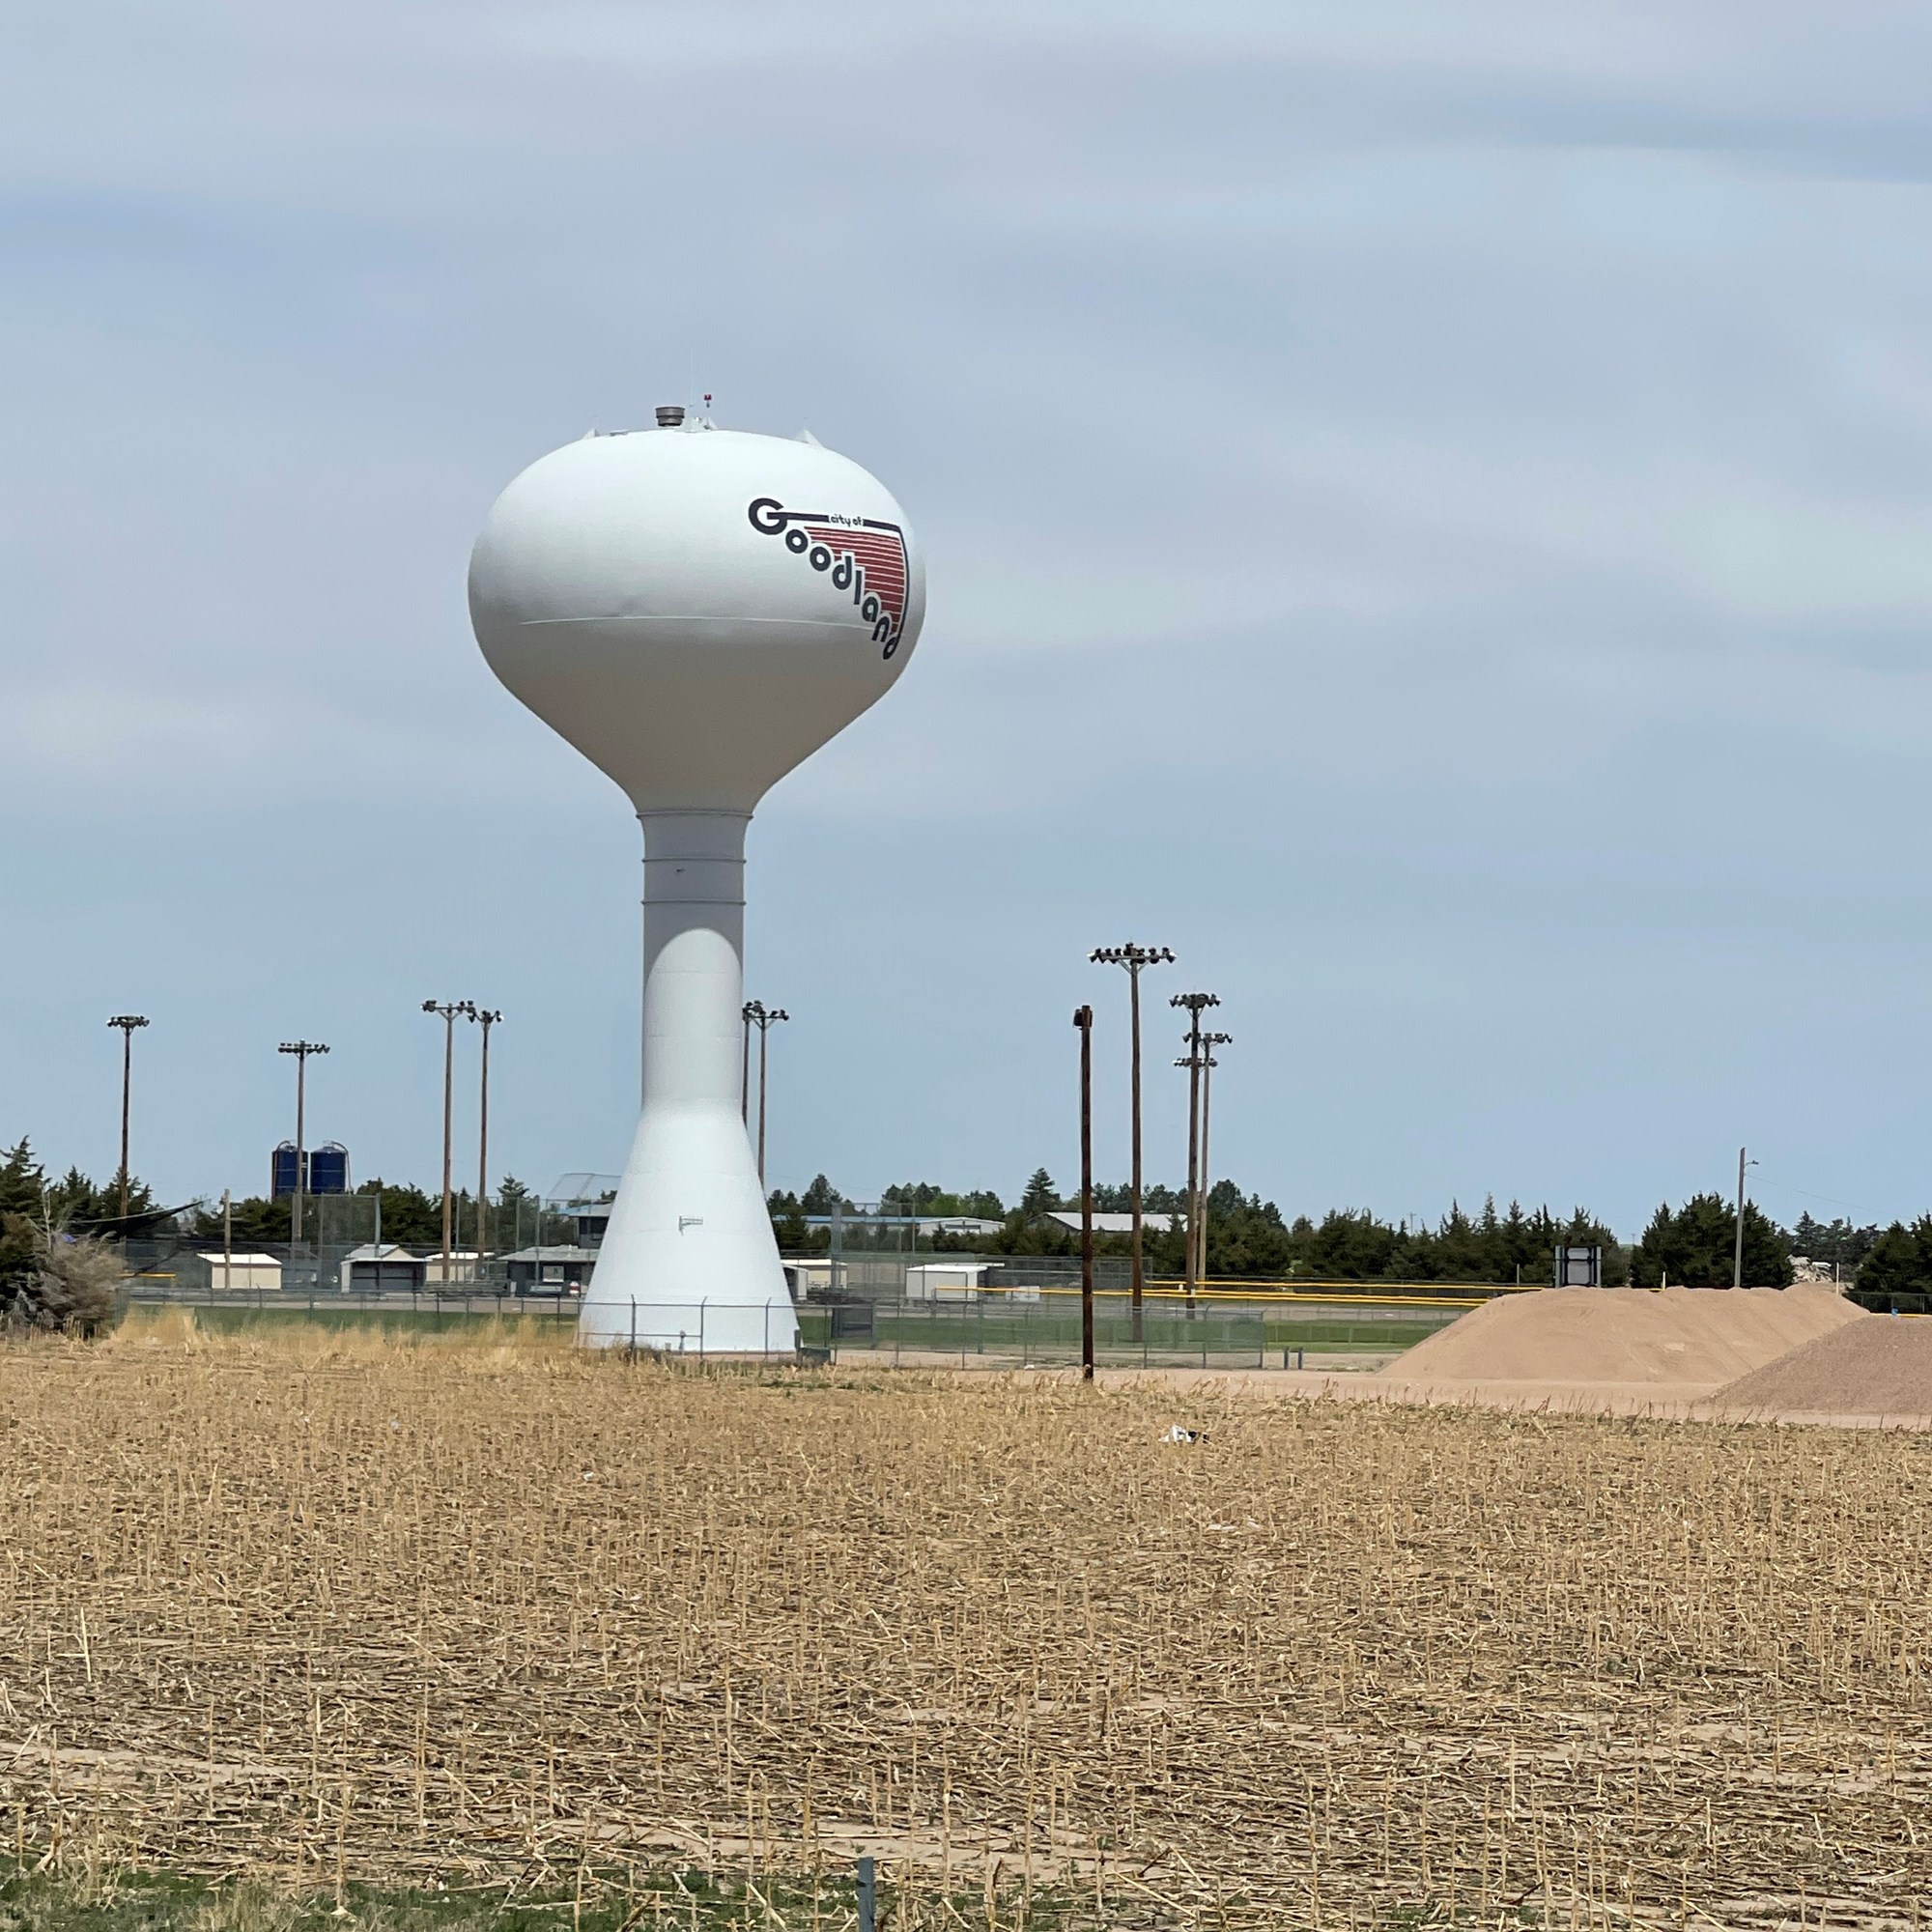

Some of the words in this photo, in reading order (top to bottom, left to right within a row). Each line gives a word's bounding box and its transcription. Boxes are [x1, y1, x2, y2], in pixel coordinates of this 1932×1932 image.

[831, 513, 851, 527] city
[852, 516, 862, 526] of
[748, 497, 909, 661] Goodland
